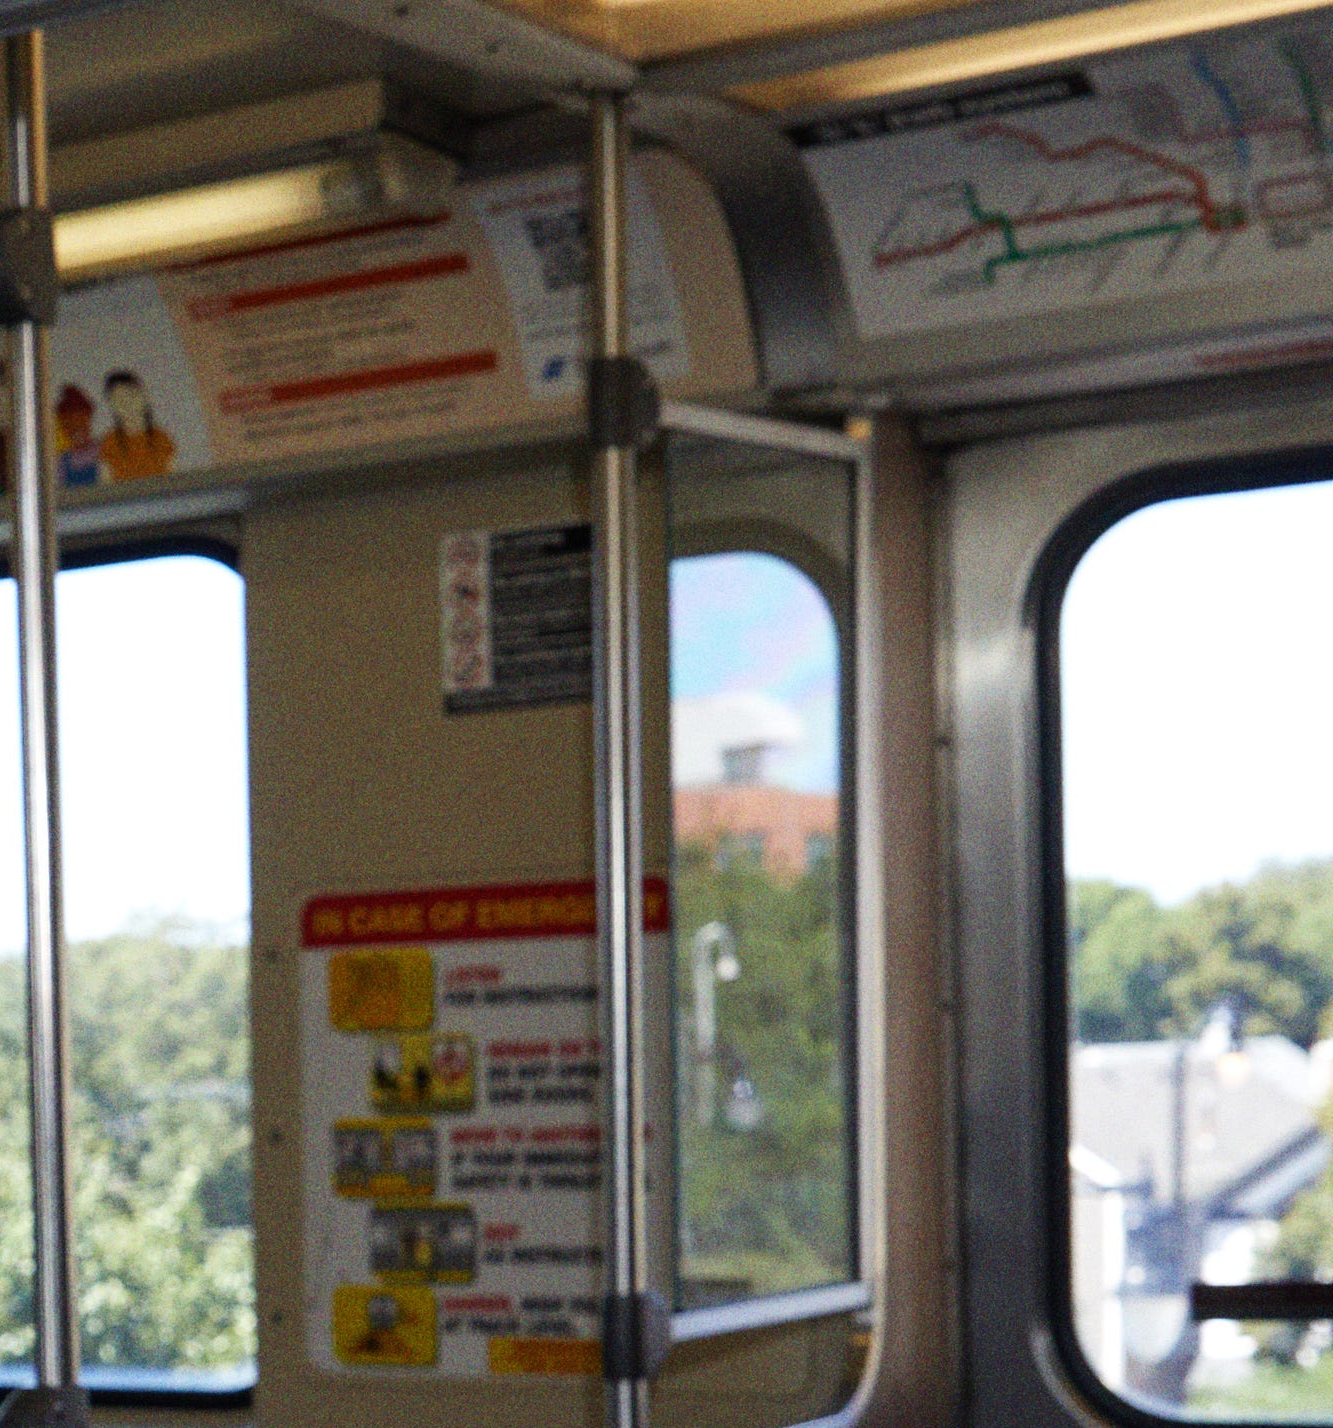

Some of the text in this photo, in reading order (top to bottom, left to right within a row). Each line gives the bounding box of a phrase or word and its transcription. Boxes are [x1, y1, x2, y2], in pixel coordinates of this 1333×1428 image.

[312, 908, 343, 936] IN
[348, 903, 423, 934] CASE
[428, 899, 469, 931] OF
